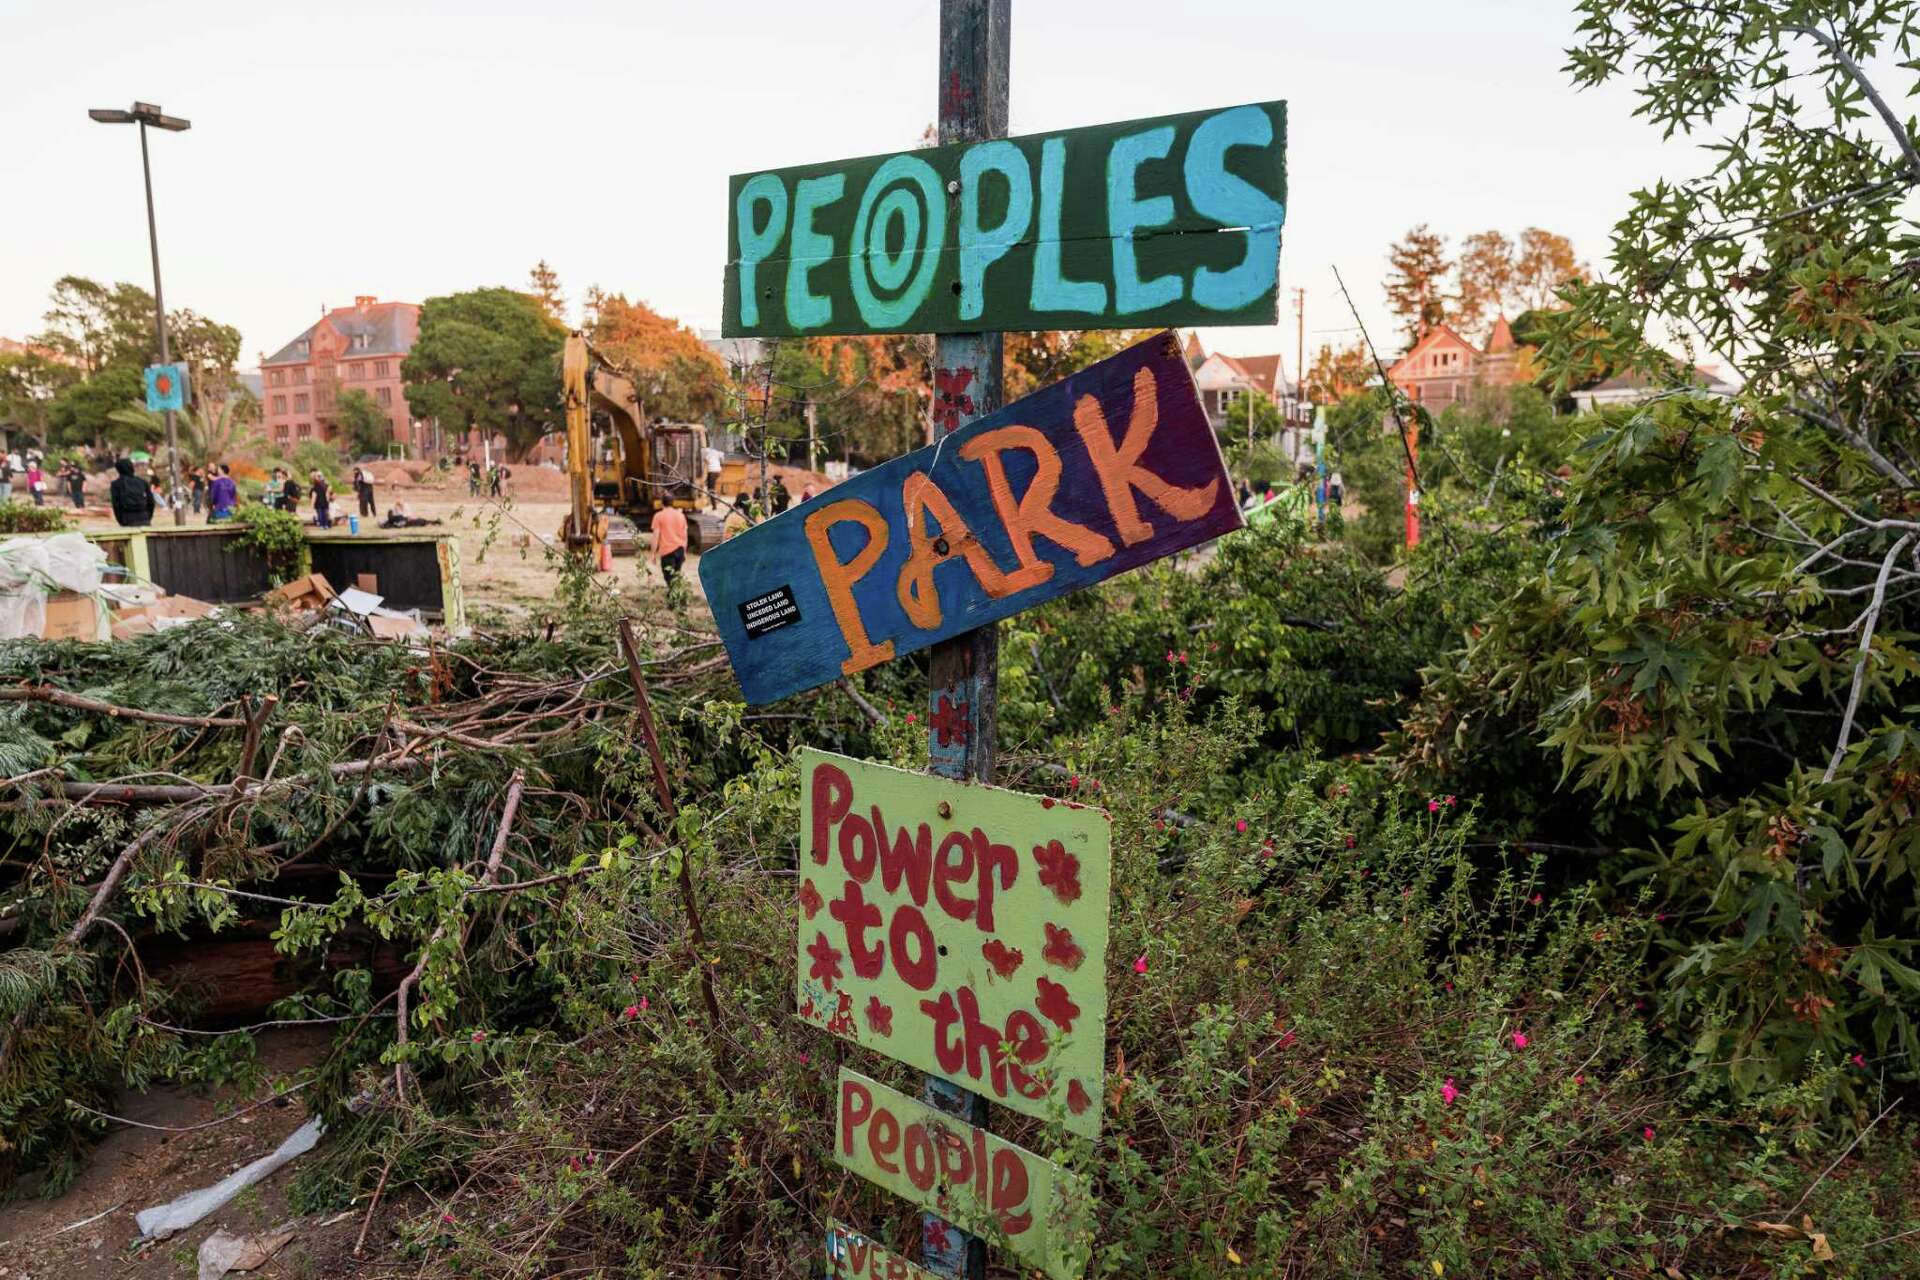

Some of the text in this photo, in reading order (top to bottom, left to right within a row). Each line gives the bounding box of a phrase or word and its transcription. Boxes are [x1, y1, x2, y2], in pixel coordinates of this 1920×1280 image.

[736, 104, 1284, 331] PEOPLES
[804, 365, 1220, 676] PARK
[746, 590, 784, 611] STOLEN LAND
[746, 598, 789, 620] UNCEDED LAND
[746, 611, 780, 630] INDIGENOUS
[780, 605, 796, 616] LAND
[811, 762, 1019, 932] Power
[829, 880, 937, 991] to
[919, 986, 1050, 1099] the
[840, 1081, 1033, 1235] People
